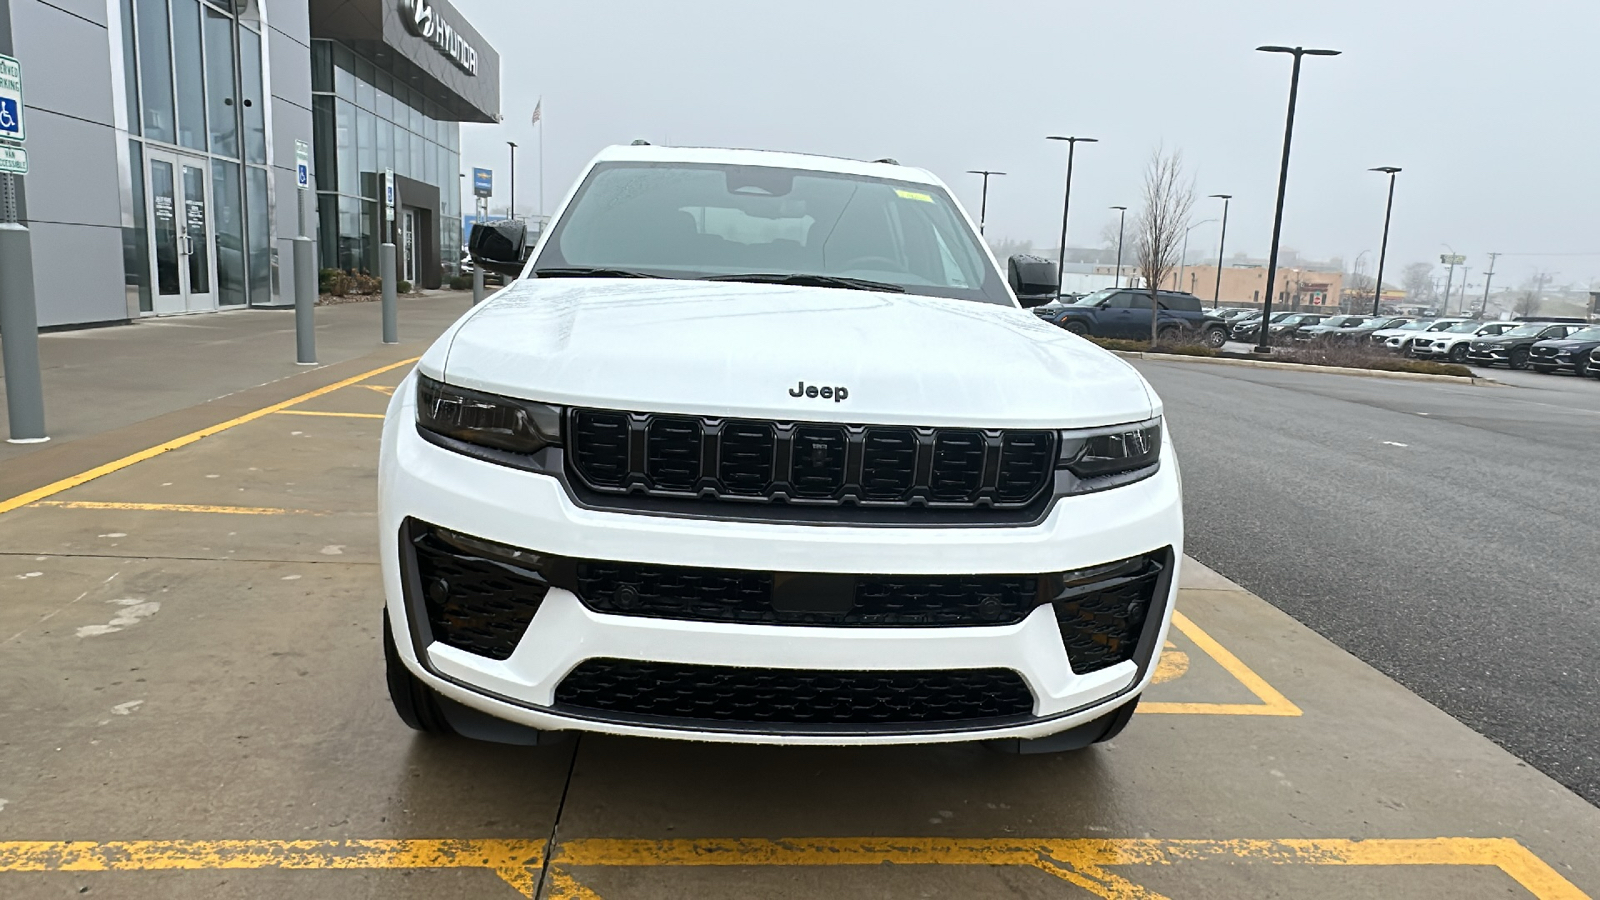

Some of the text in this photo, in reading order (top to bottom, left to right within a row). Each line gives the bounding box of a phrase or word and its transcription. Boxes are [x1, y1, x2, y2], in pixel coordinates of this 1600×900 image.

[436, 13, 478, 76] HYUNDAI
[5, 150, 15, 159] VAN
[789, 381, 849, 403] Jeep
